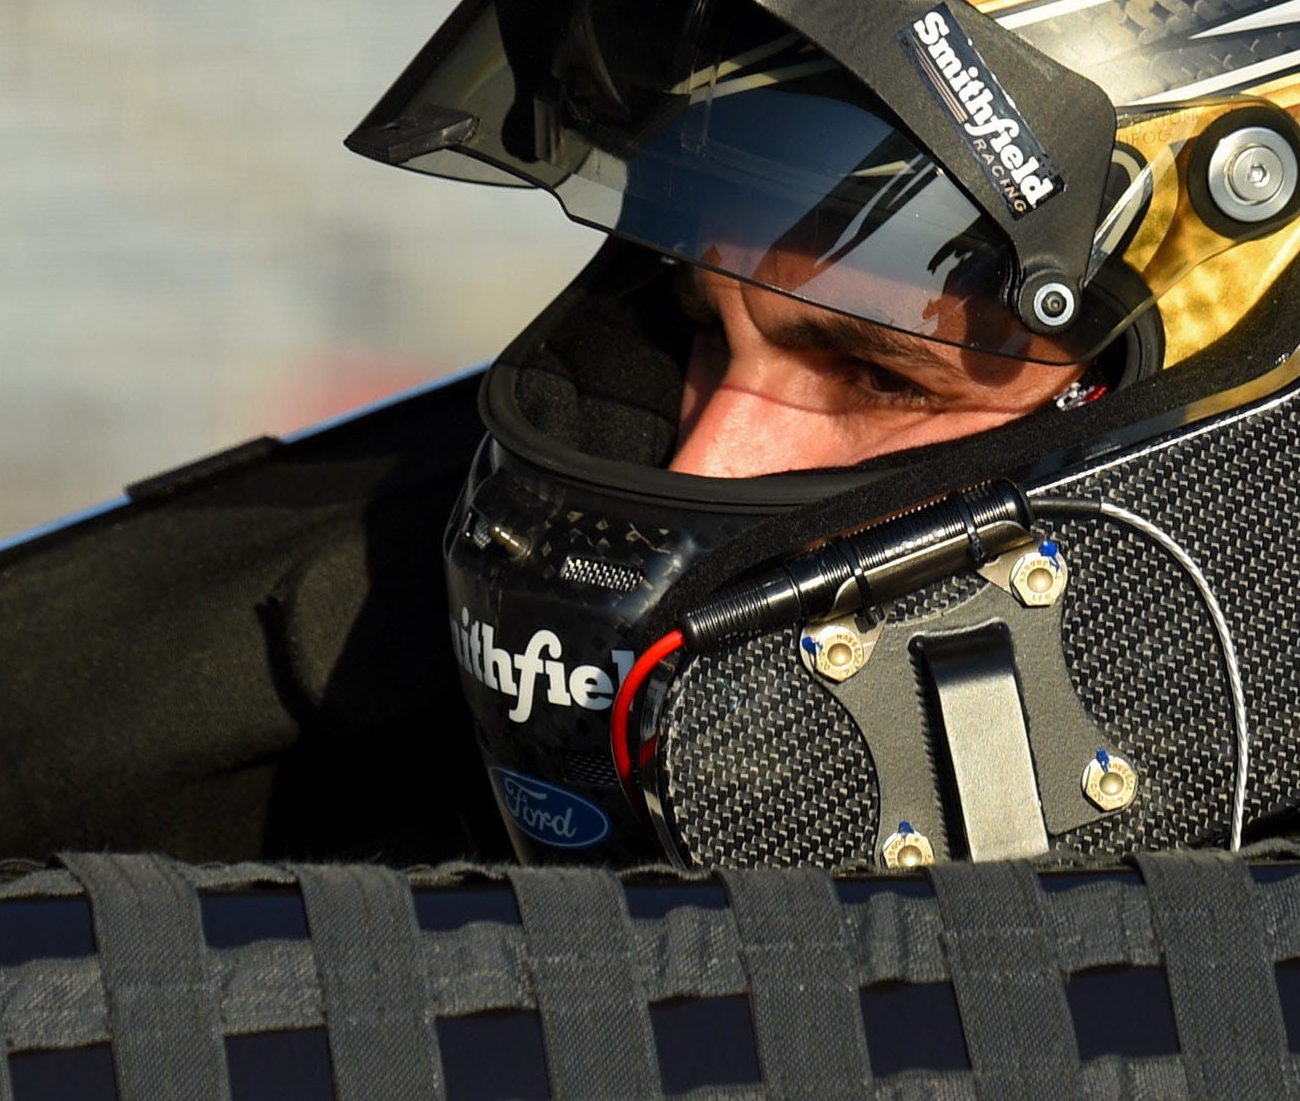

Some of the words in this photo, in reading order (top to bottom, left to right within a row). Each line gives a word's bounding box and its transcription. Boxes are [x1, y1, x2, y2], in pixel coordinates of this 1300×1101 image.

[913, 11, 1054, 207] Smithfield
[972, 137, 1028, 213] RACING
[503, 776, 578, 839] Ford
